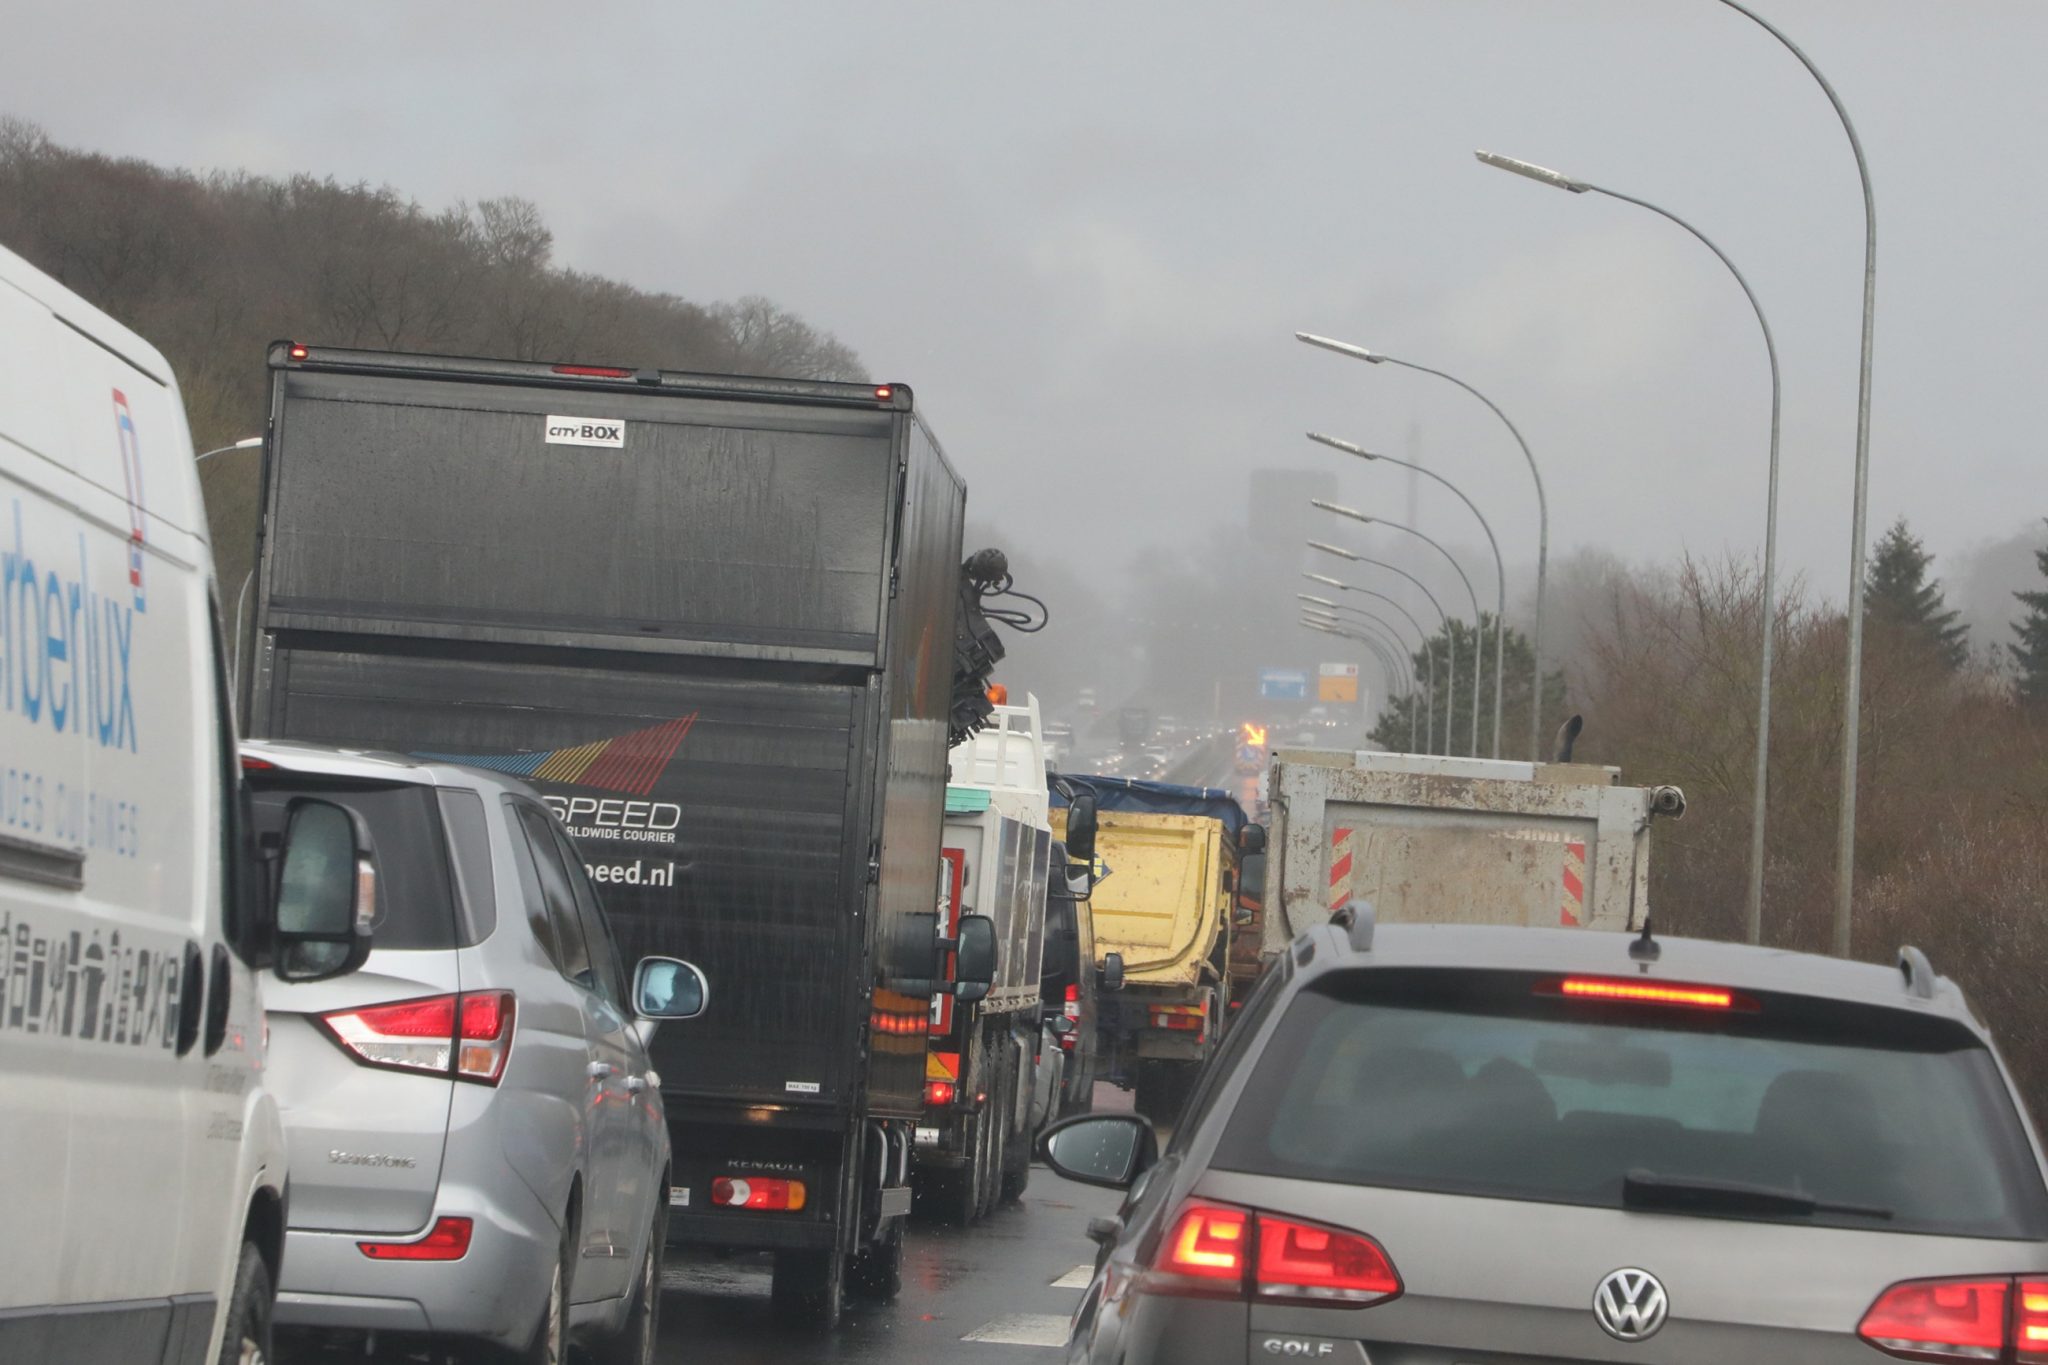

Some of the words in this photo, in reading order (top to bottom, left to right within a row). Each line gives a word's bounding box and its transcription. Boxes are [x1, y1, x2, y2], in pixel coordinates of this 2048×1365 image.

[549, 427, 579, 437] CITY
[581, 425, 620, 440] BOX
[0, 498, 137, 753] rberlux
[542, 796, 681, 829] SPEED
[566, 826, 621, 839] RLDWIDE
[623, 830, 675, 843] COURIER
[1263, 1339, 1333, 1357] GOLF
